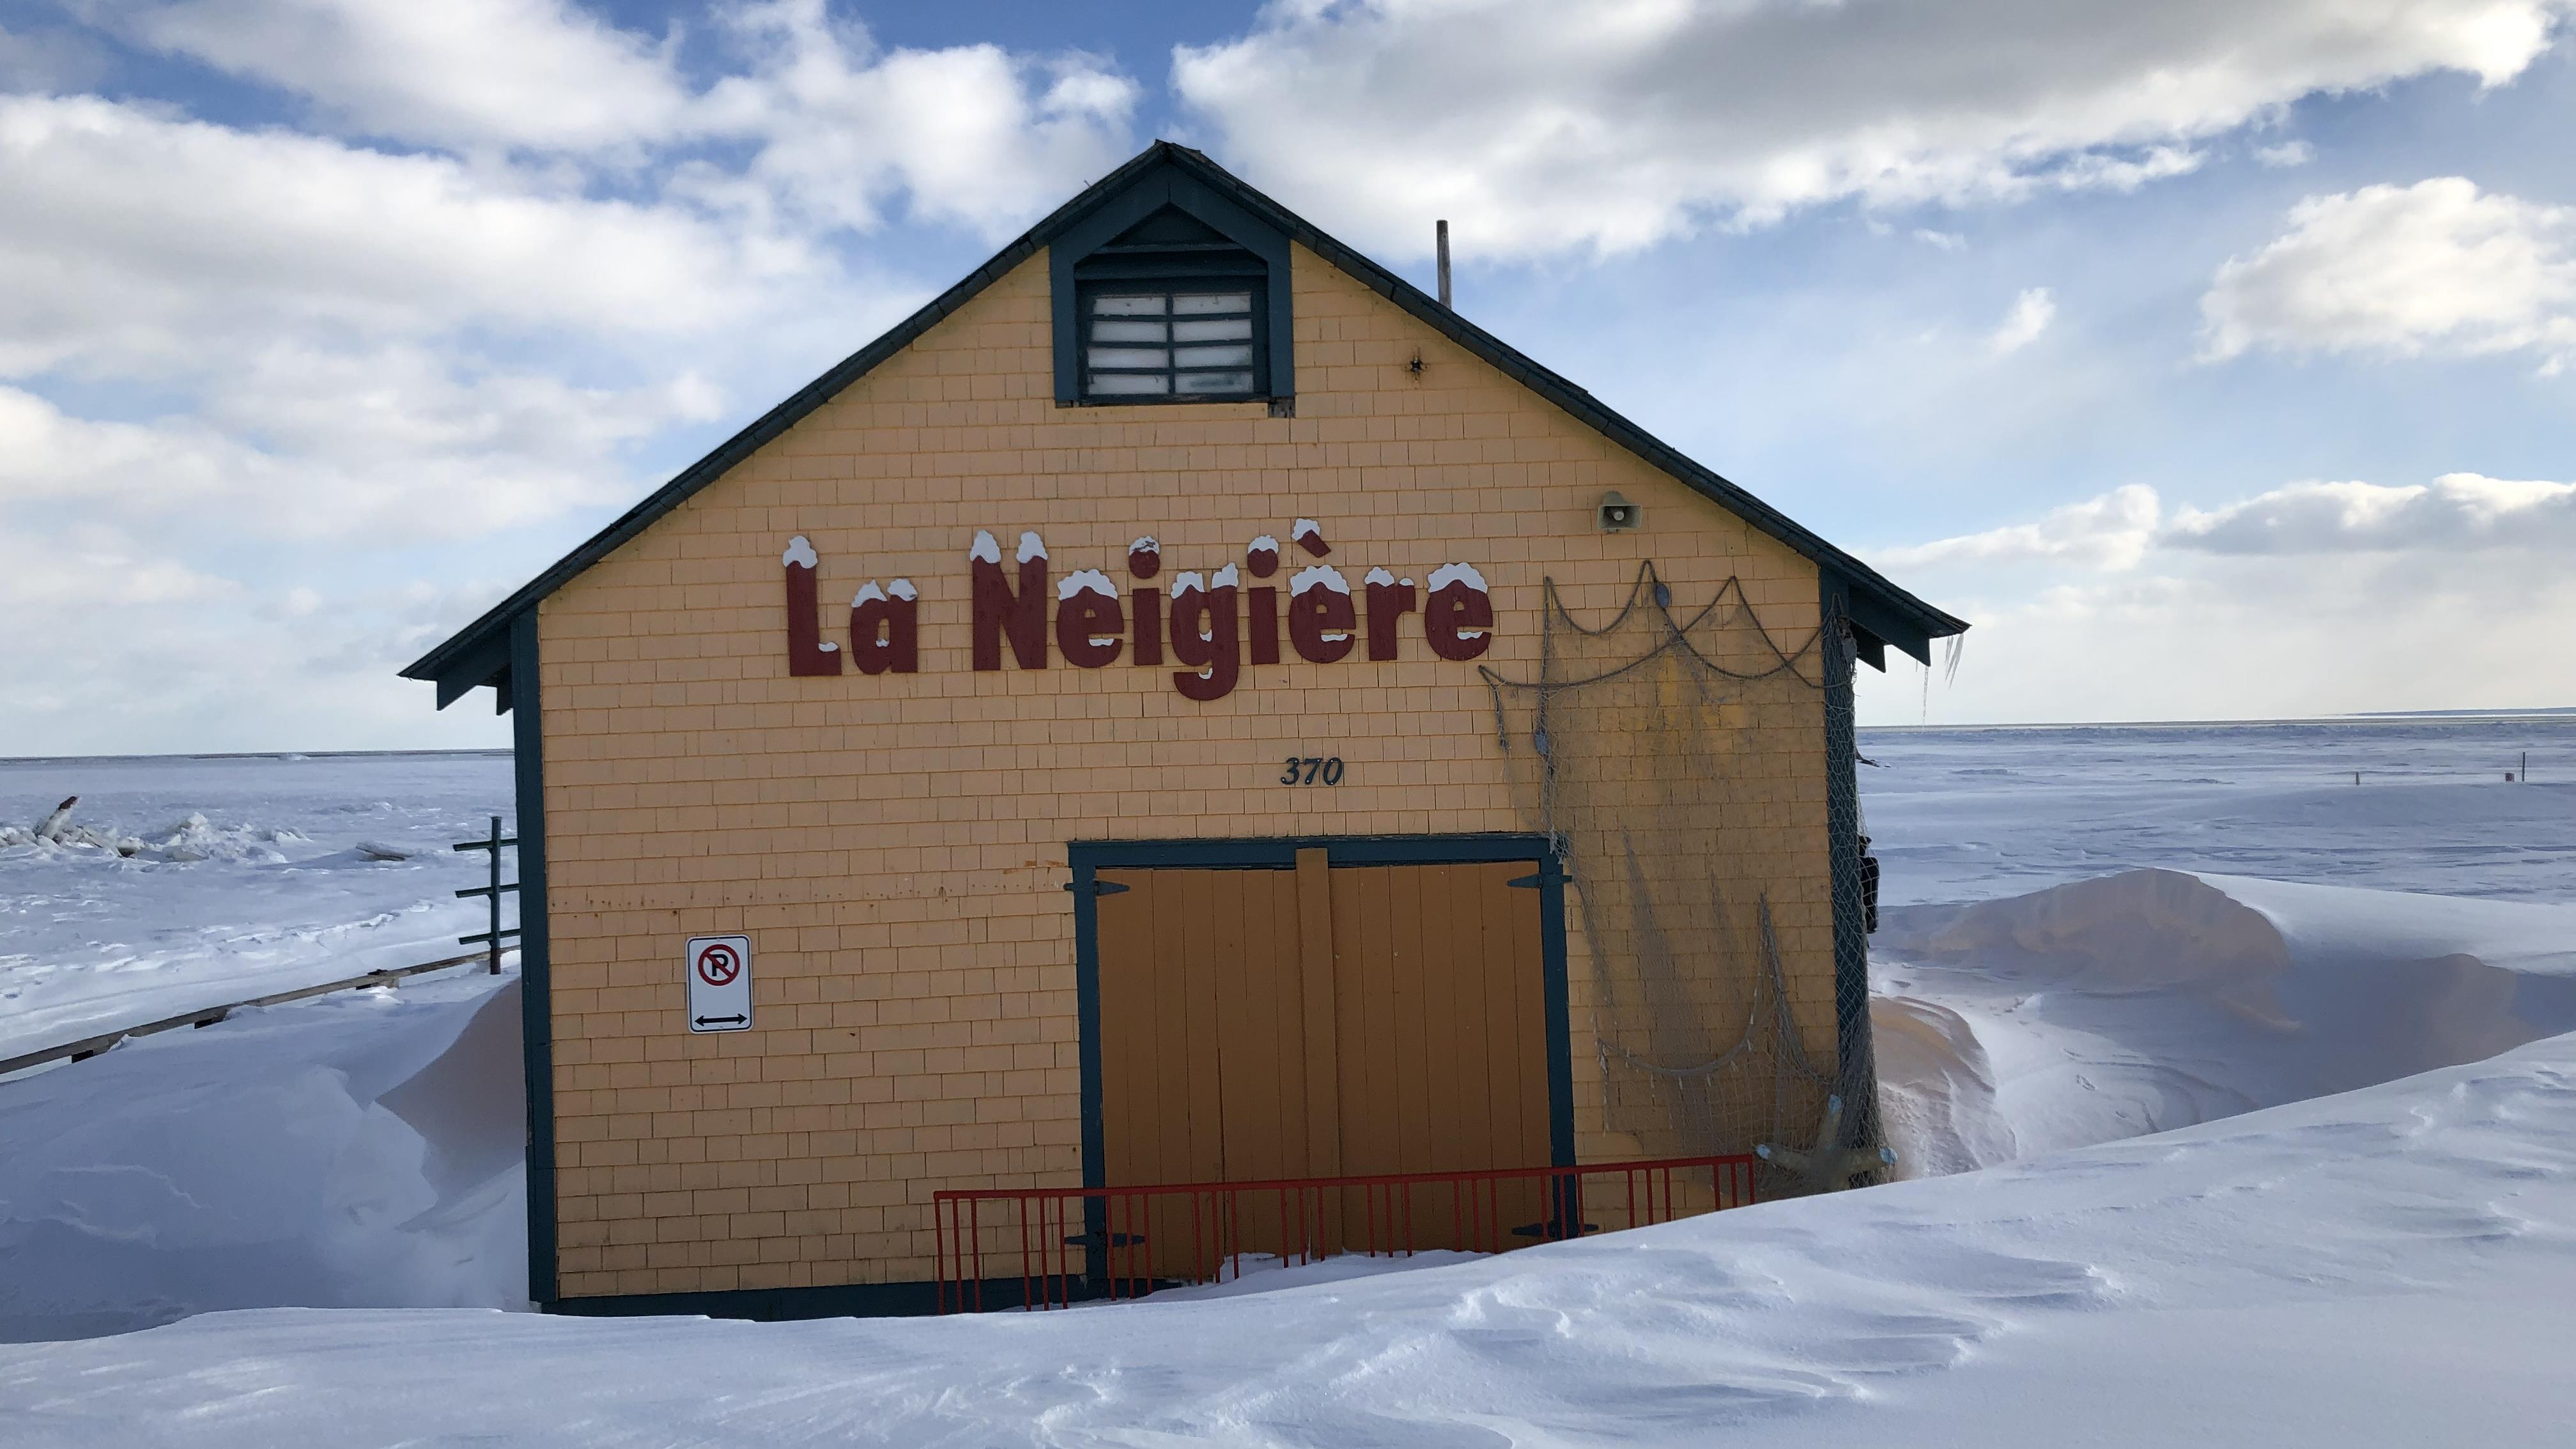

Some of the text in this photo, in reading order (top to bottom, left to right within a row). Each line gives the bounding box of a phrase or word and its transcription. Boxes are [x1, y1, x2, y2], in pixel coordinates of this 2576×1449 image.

[783, 518, 1493, 701] La Neigière
[1280, 757, 1343, 786] 370
